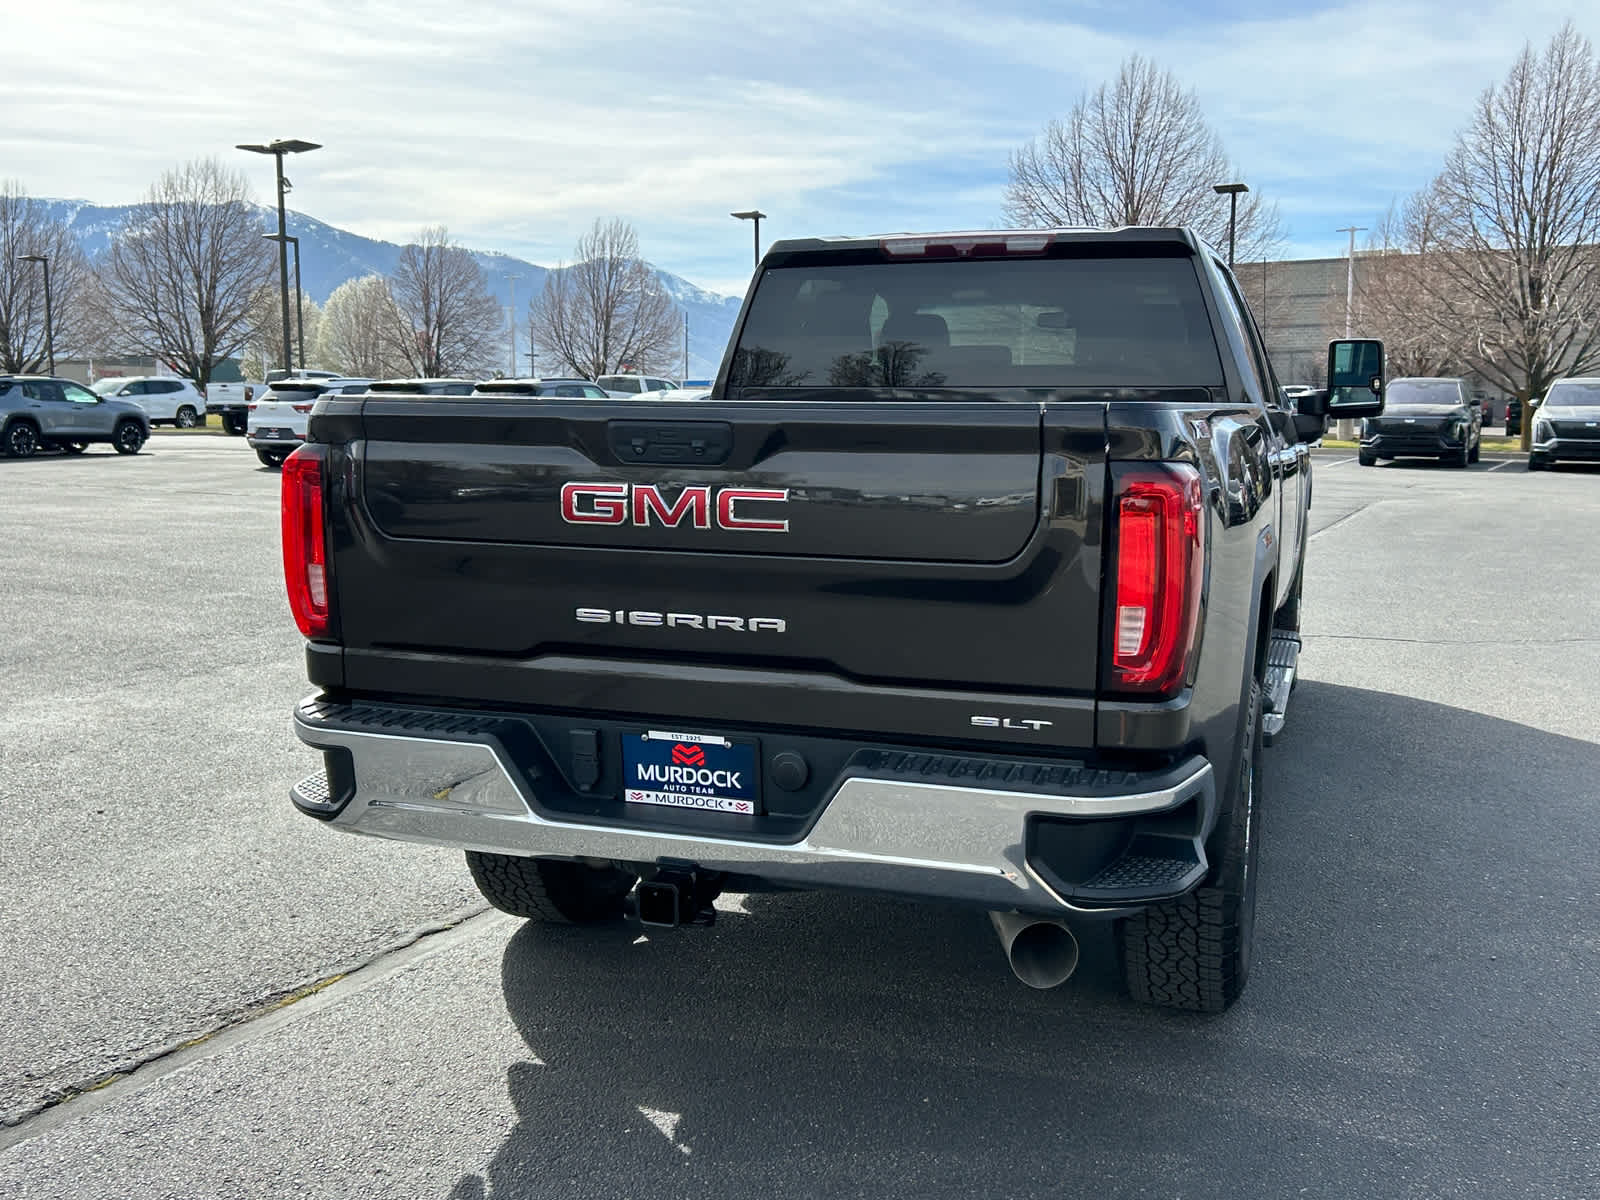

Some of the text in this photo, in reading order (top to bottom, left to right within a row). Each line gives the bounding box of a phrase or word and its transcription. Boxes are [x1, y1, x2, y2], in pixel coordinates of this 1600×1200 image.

[560, 481, 790, 533] GMC
[575, 607, 787, 633] SIERRA
[970, 715, 1054, 731] SLT
[637, 763, 742, 789] MURDOCK
[663, 784, 715, 795] AUTO TEAM
[655, 793, 724, 810] MURDOCK
